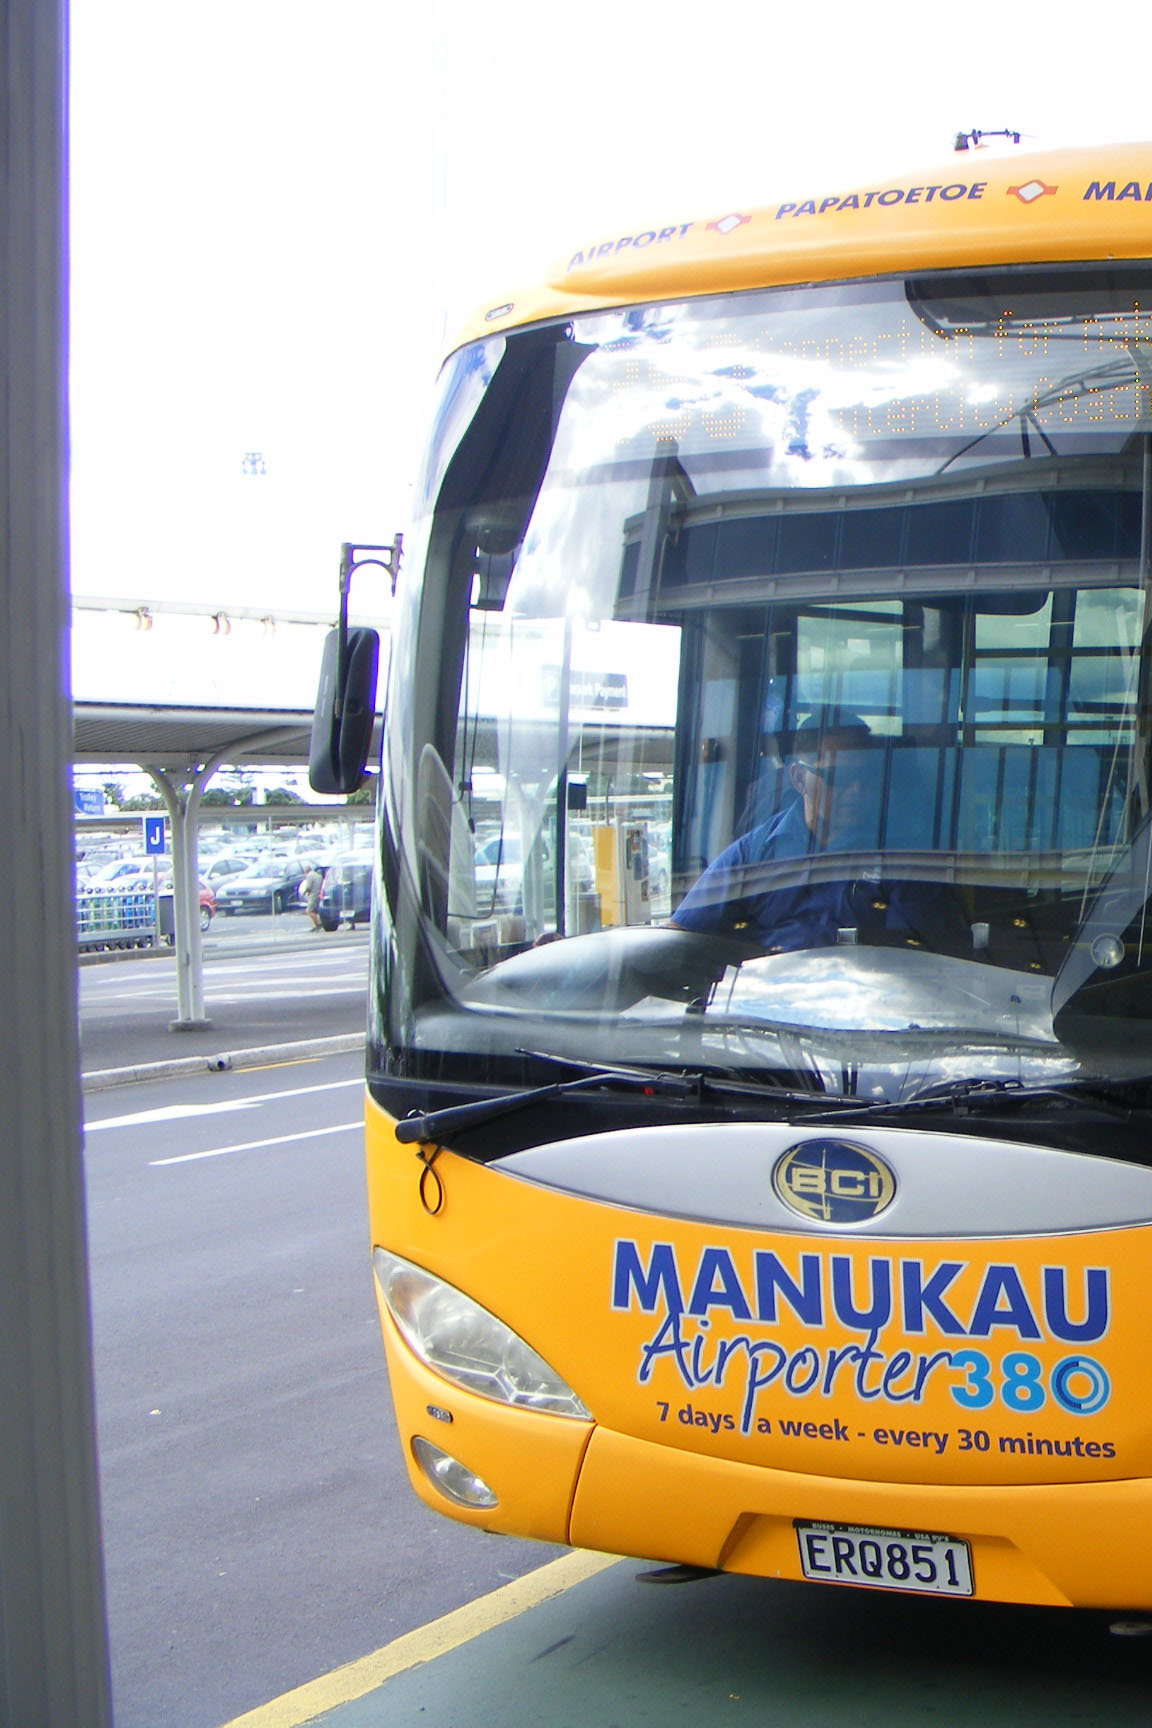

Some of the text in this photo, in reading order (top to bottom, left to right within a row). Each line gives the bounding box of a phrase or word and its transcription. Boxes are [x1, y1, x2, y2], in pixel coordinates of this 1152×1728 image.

[567, 222, 693, 273] AIRPORT
[775, 182, 986, 220] PAPATOETOE
[994, 311, 1059, 359] for
[150, 826, 160, 845] J
[791, 1165, 882, 1198] BCI
[611, 1239, 1111, 1343] MANUKAU
[639, 1306, 1111, 1435] Airporter 380
[656, 1402, 668, 1422] 7
[678, 1405, 735, 1432] days
[757, 1419, 772, 1435] a
[779, 1419, 849, 1442] week
[873, 1431, 948, 1455] every
[957, 1429, 990, 1453] 30
[999, 1432, 1117, 1459] minutes
[805, 1534, 960, 1587] ERQ851
